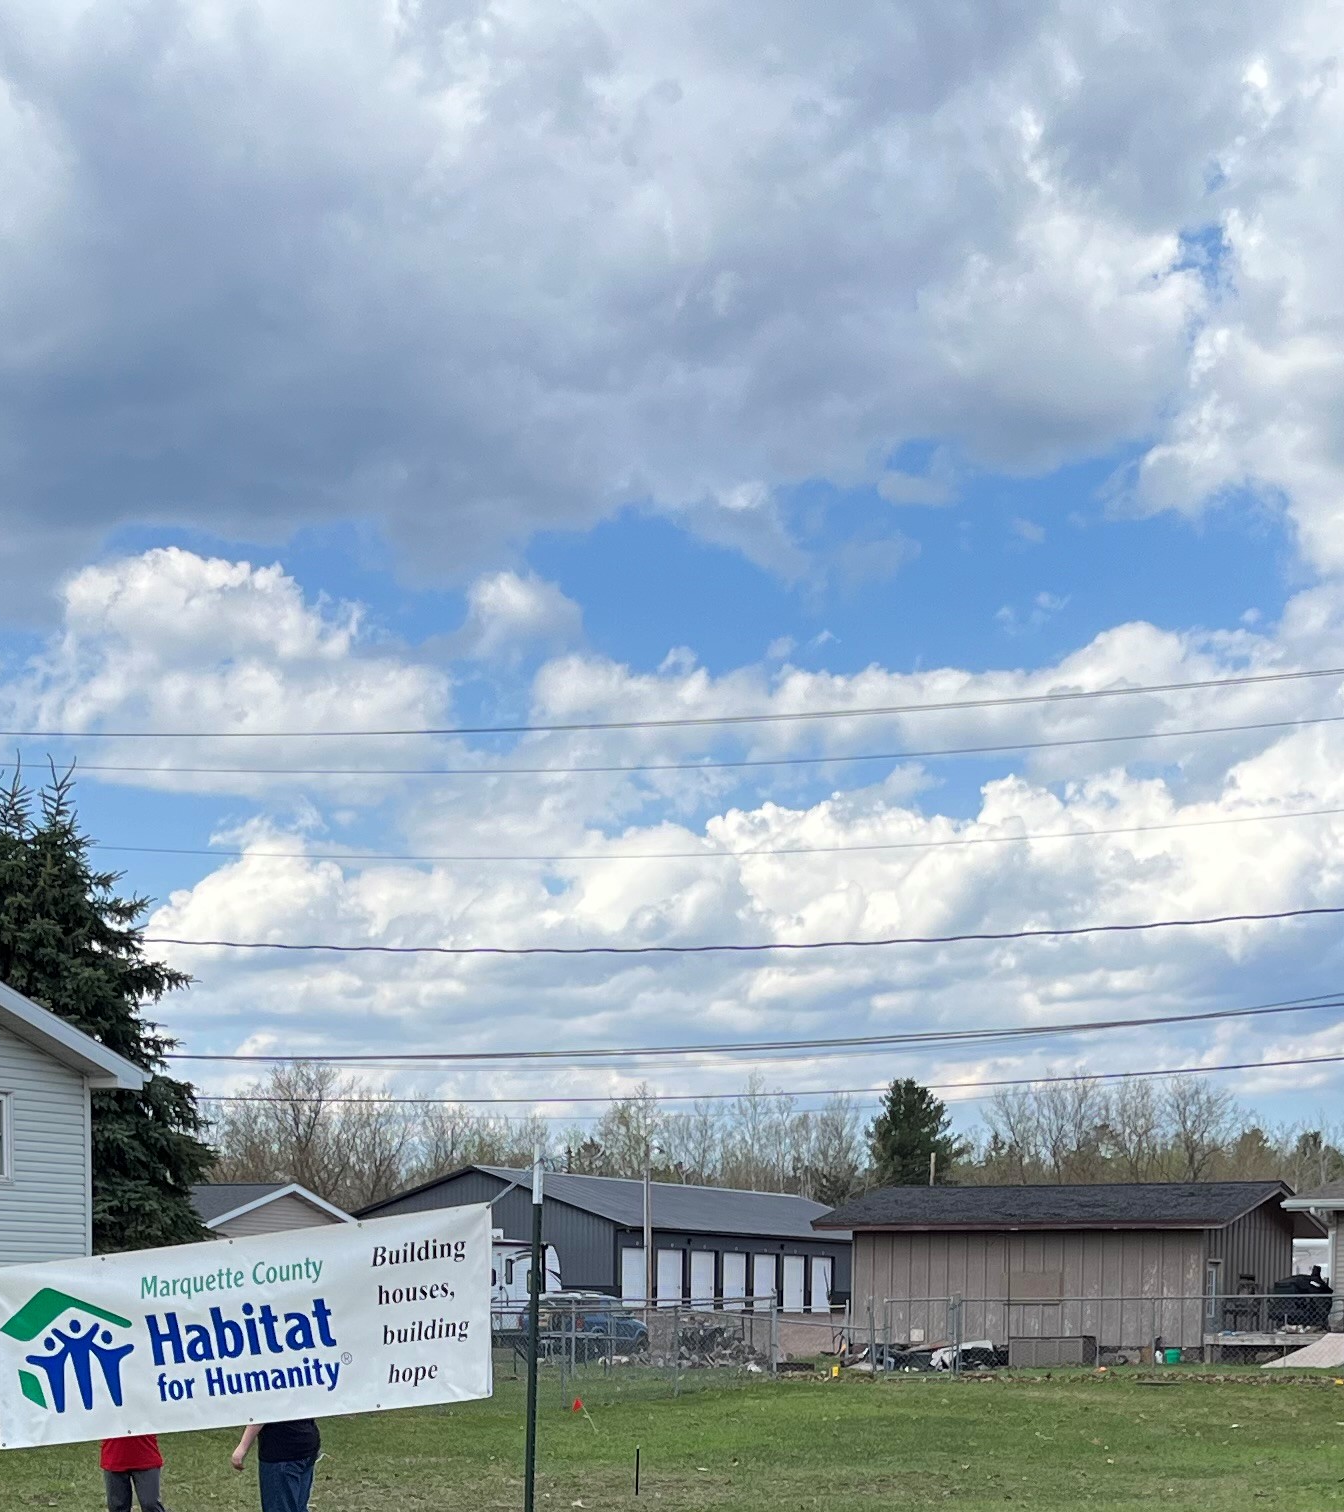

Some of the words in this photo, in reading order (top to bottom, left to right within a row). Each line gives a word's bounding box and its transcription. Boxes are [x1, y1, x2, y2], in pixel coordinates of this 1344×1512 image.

[370, 1238, 466, 1268] Building
[141, 1268, 244, 1299] Marquette
[252, 1257, 323, 1286] County
[378, 1282, 455, 1306] houses,
[144, 1298, 337, 1366] Habitat
[382, 1318, 469, 1346] building
[157, 1372, 196, 1402] for
[388, 1363, 438, 1388] hope
